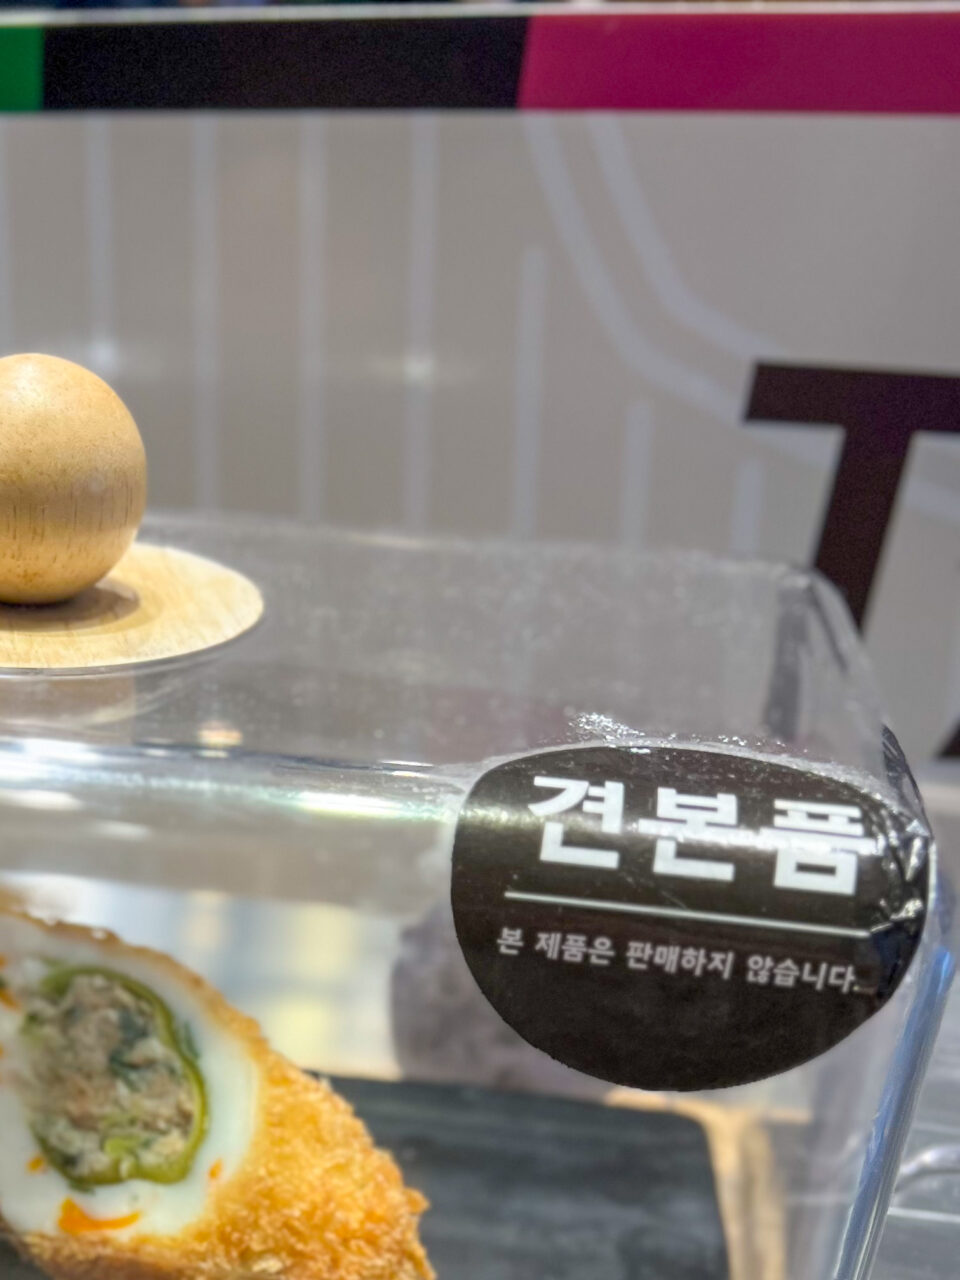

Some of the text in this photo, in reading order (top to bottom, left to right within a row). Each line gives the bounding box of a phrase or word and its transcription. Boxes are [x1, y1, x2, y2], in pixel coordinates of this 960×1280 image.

[528, 774, 880, 896] 견본품
[497, 927, 860, 994] 본 제품은 판매하지 않습니다.
